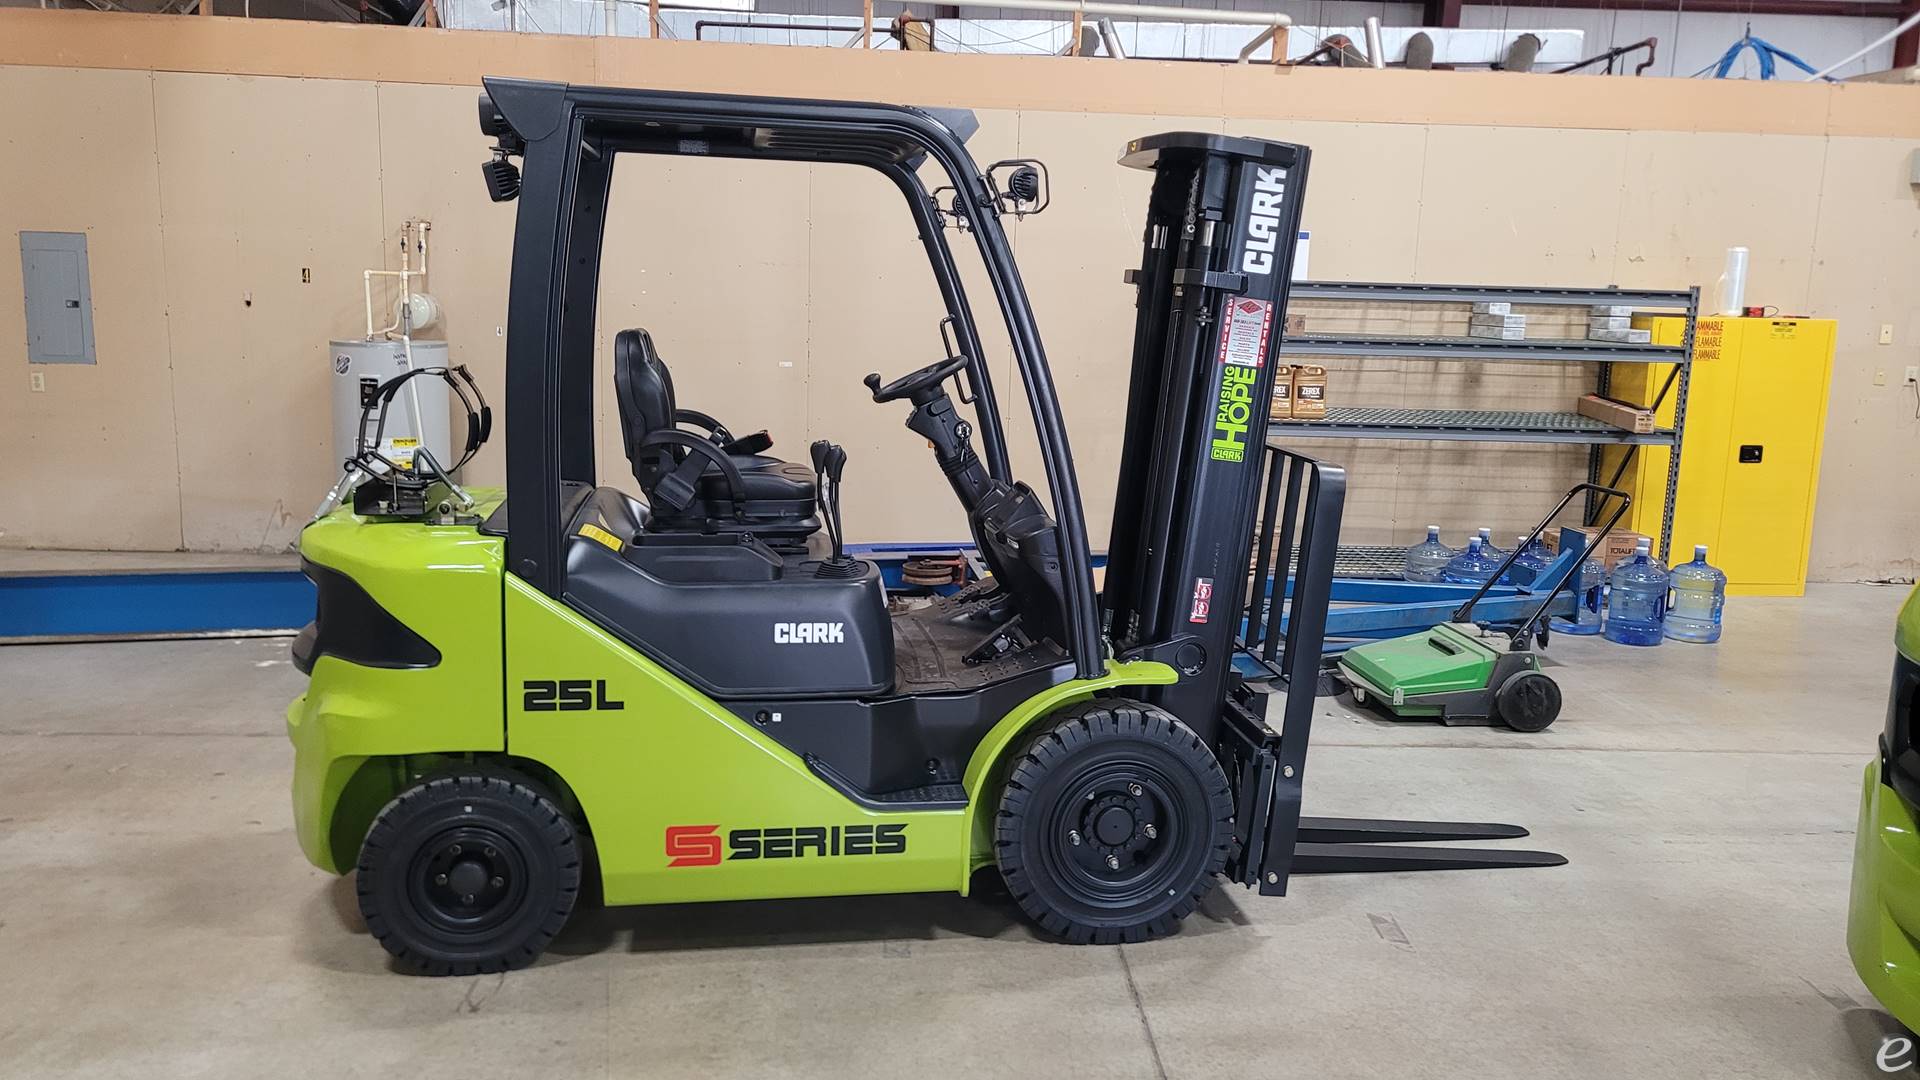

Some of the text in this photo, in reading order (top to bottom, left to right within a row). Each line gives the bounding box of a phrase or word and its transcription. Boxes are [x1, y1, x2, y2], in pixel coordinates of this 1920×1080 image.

[1243, 167, 1287, 275] CLARK
[1220, 298, 1234, 360] SERVICE
[1258, 303, 1273, 364] RENTALS
[1695, 336, 1722, 347] FLAMABLE
[1696, 321, 1724, 331] AMMABLE
[1693, 349, 1721, 360] FLAMMABLE
[1217, 366, 1235, 421] RAISING
[1302, 387, 1320, 395] ZEREX
[1213, 367, 1257, 450] HOPE
[1213, 449, 1242, 460] CLARK
[774, 622, 844, 643] CLARK
[523, 679, 624, 711] 25L
[726, 823, 909, 861] SERIES
